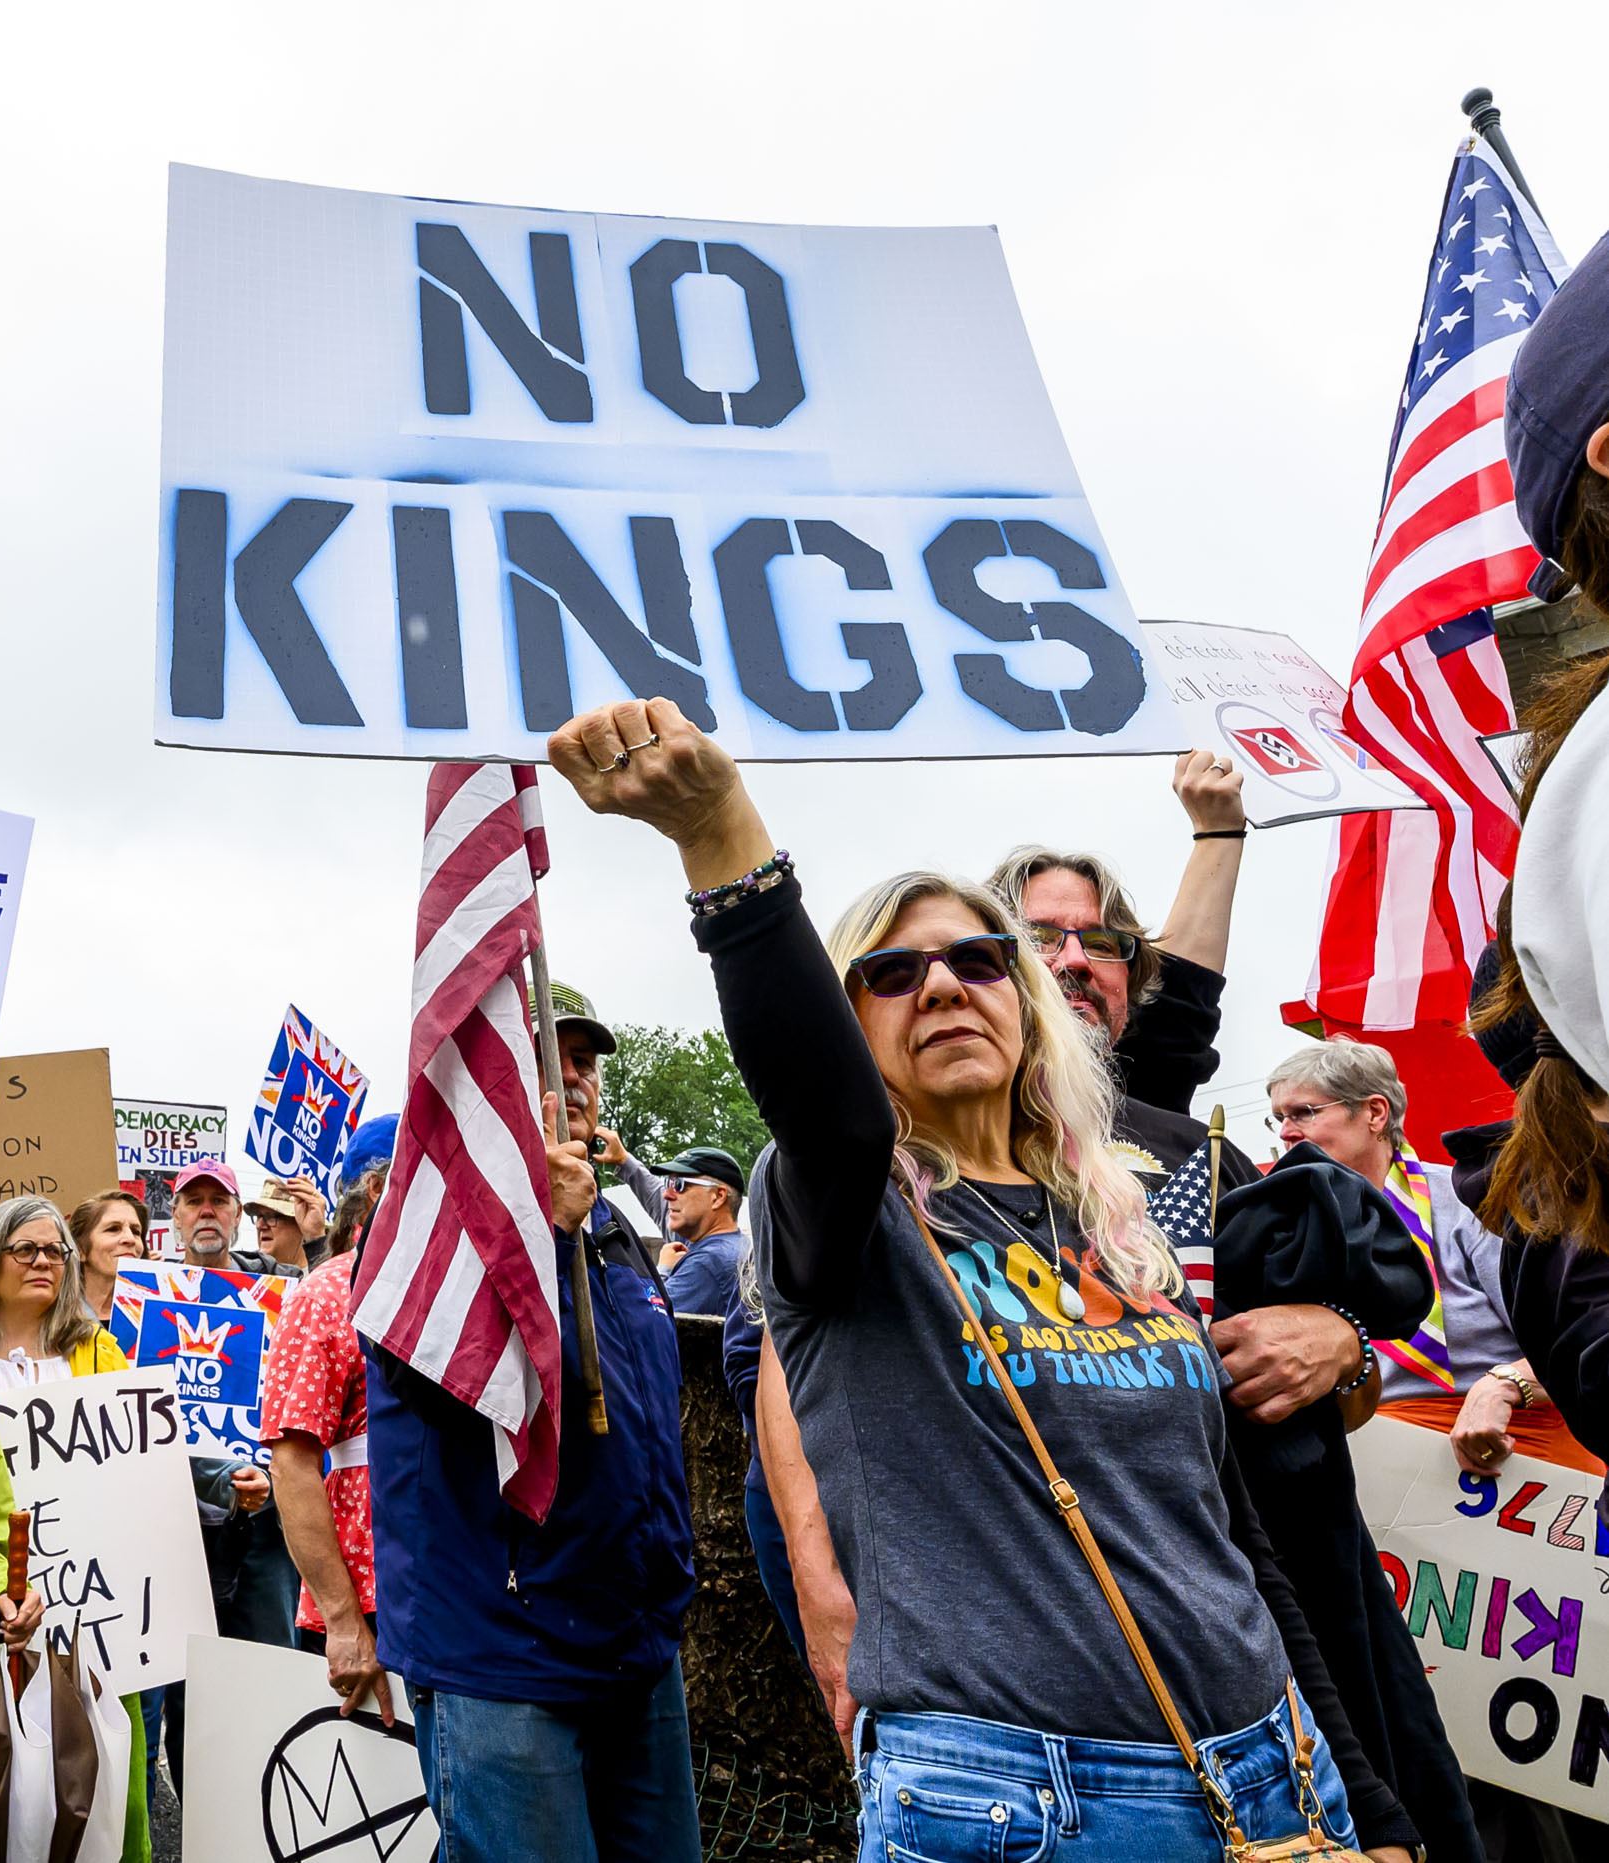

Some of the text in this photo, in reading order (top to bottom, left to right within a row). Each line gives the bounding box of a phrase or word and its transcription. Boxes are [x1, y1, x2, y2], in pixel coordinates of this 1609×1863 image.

[414, 221, 805, 428] NO
[169, 487, 1147, 737] KINGS
[114, 1107, 227, 1134] DEMOCRACY
[295, 1105, 322, 1140] NO
[2, 1135, 42, 1157] ON
[144, 1129, 198, 1150] DIES
[291, 1124, 318, 1152] KINGS
[117, 1145, 142, 1164] IN
[1020, 1323, 1076, 1353] NOT
[1074, 1327, 1138, 1354] THE
[175, 1356, 223, 1385] NO
[1044, 1345, 1176, 1389] THINK
